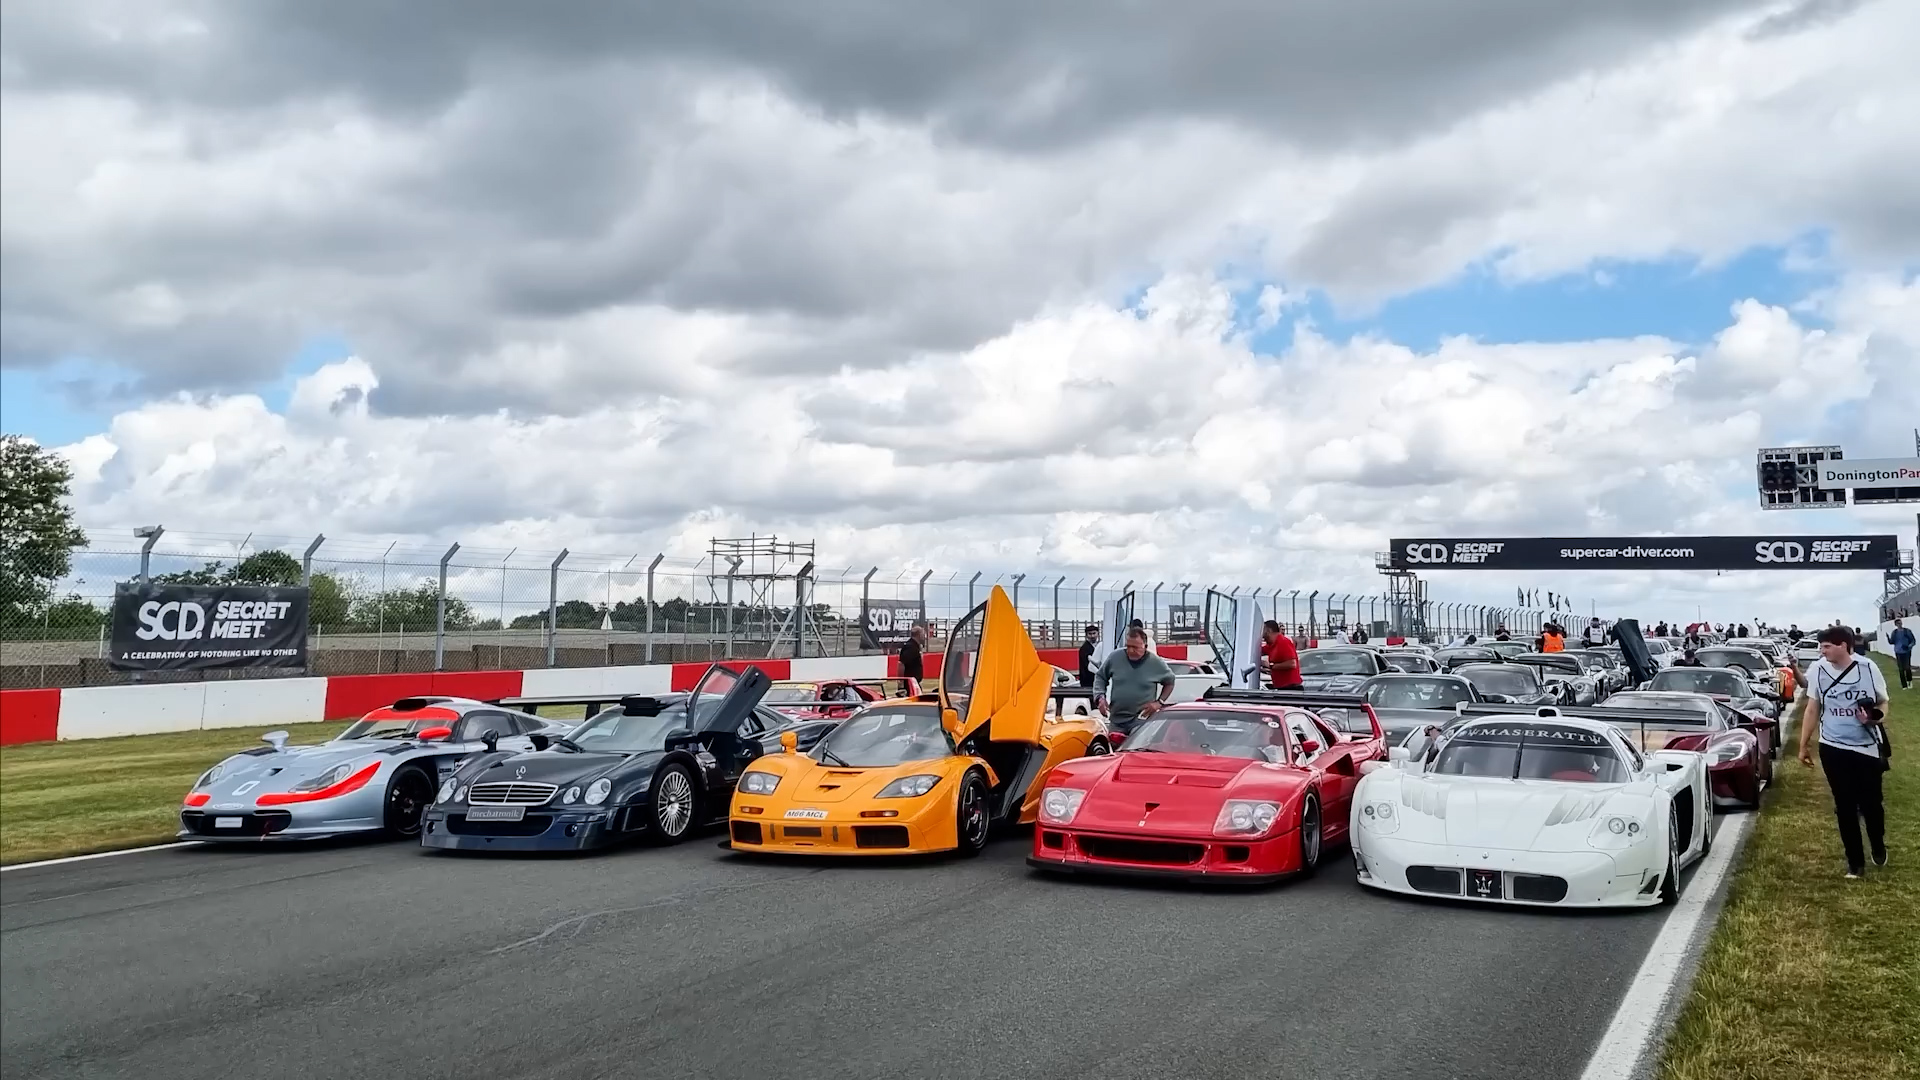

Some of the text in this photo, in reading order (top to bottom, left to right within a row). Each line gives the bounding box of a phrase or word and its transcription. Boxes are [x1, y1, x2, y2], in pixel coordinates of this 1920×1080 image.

[1453, 542, 1504, 553] SECRET
[1811, 541, 1871, 551] SECRET
[1452, 553, 1489, 563] MEET
[1560, 545, 1695, 560] supercar-driver.com
[1809, 552, 1852, 562] MEET
[215, 601, 291, 619] SECRET
[894, 608, 920, 619] SECRET
[893, 620, 913, 631] MEET
[122, 652, 129, 660] A
[130, 651, 186, 660] CELEBRATION
[187, 650, 200, 658] OF
[200, 649, 242, 658] MOTORING
[272, 648, 298, 656] OTHER
[1845, 690, 1868, 700] 073
[1480, 728, 1586, 742] MASERATI
[471, 809, 520, 818] mechatronik
